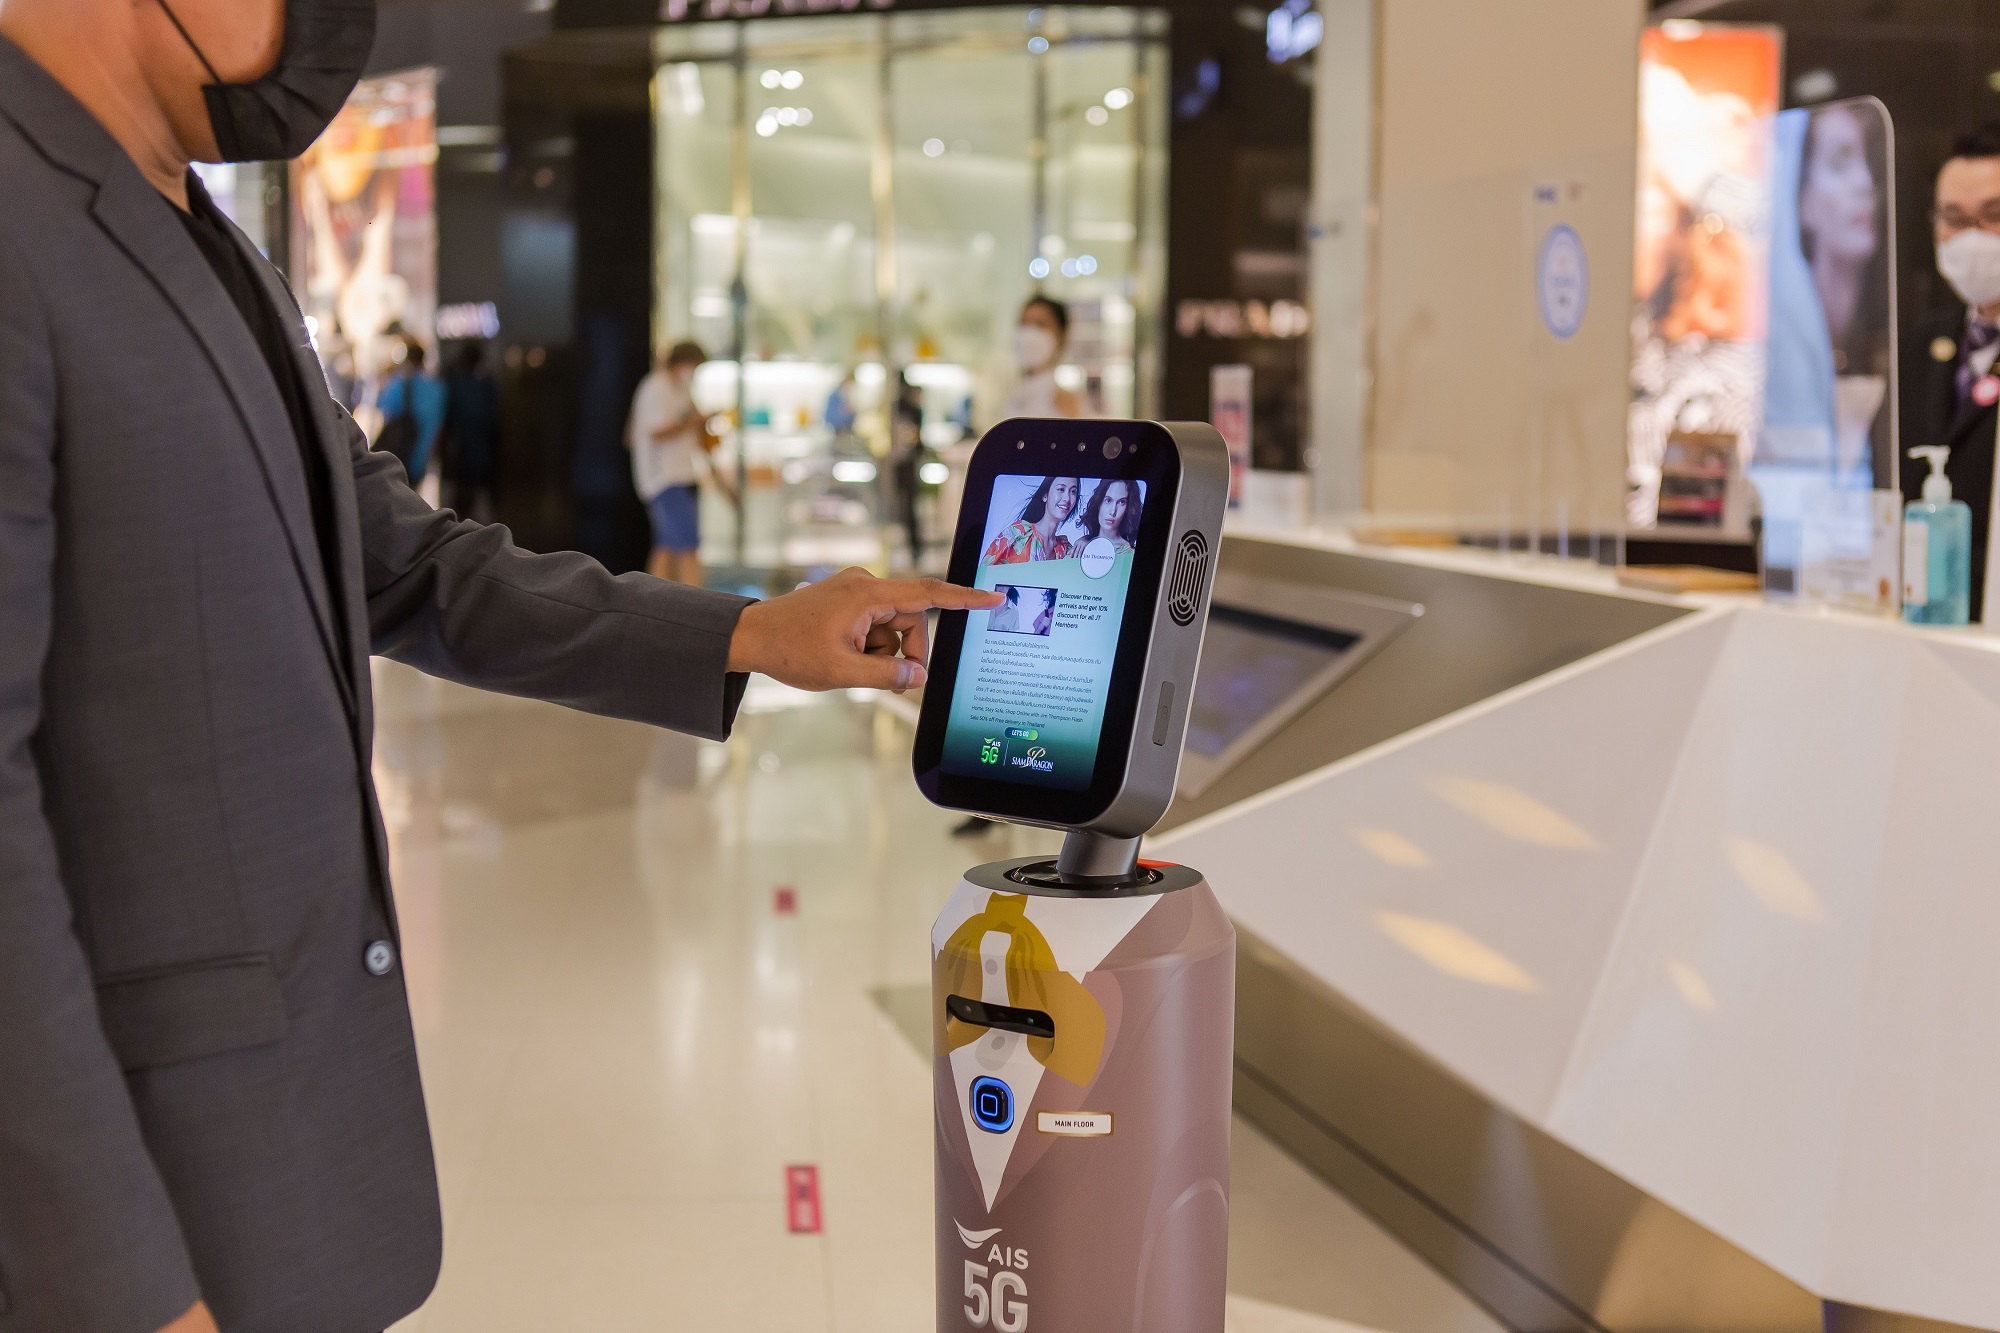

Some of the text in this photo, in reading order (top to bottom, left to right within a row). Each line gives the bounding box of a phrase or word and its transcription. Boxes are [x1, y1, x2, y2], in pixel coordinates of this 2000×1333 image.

[1060, 592, 1082, 600] Discover
[1058, 602, 1077, 610] arrivals
[1054, 621, 1078, 629] Members
[1047, 713, 1071, 722] Thompson
[1004, 718, 1021, 726] delivery
[1026, 720, 1045, 728] Thailand
[1011, 729, 1022, 737] LET'S
[992, 740, 1001, 748] AIS
[981, 745, 999, 765] 5G
[987, 1243, 1029, 1270] AIS
[964, 1259, 1029, 1333] 5G
